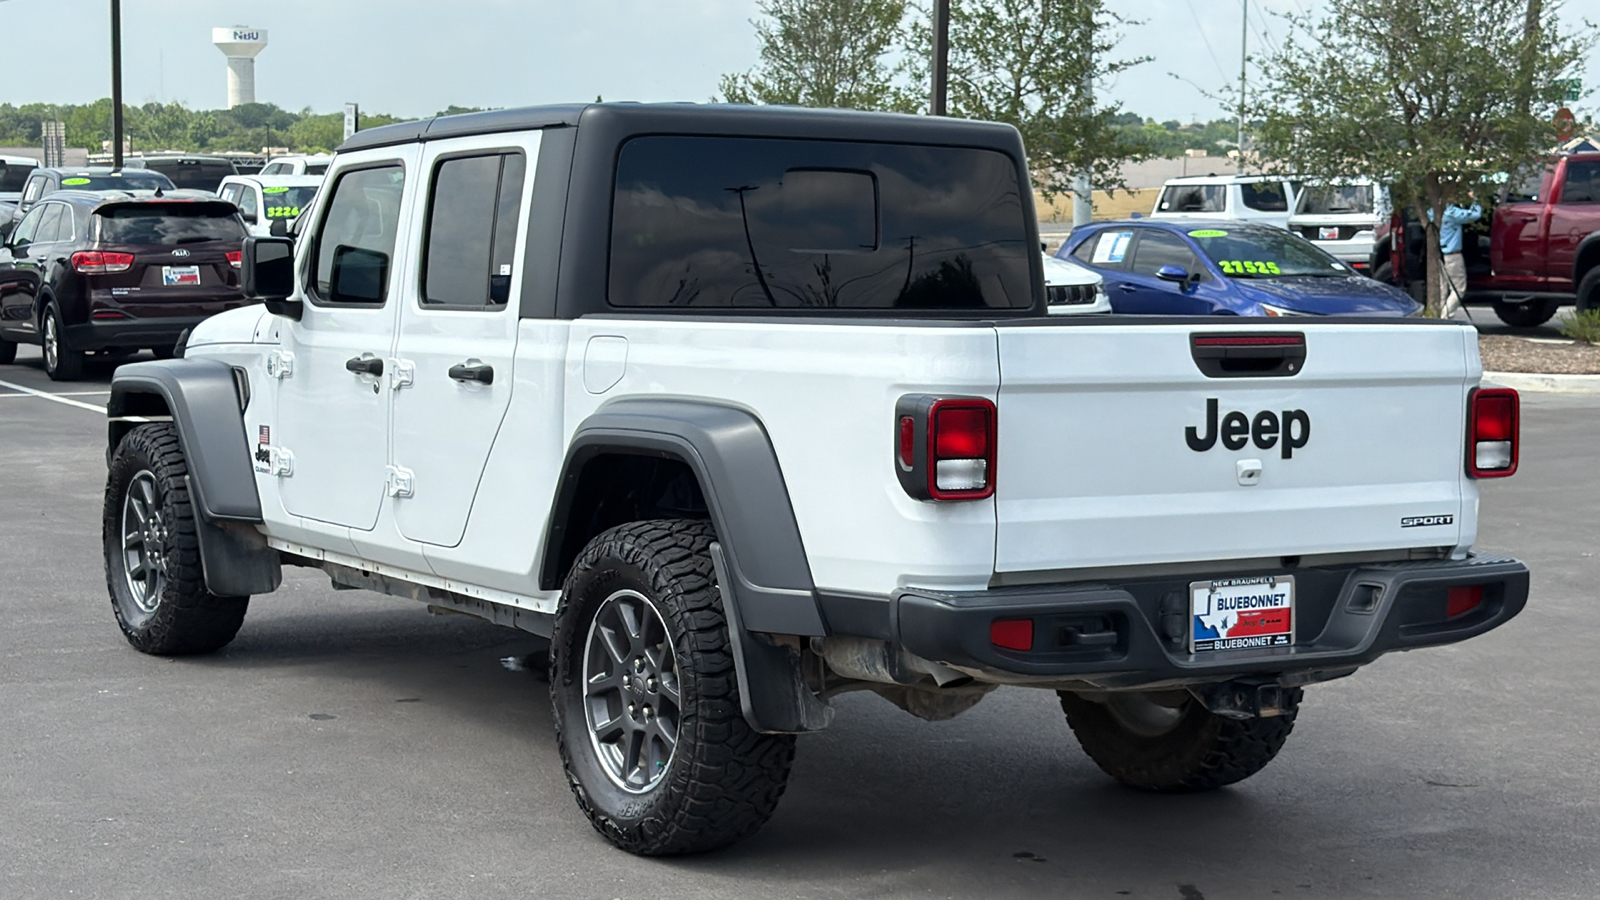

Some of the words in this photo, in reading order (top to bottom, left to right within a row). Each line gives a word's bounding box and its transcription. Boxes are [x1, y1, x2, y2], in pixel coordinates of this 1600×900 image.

[267, 206, 306, 218] 3226
[1218, 260, 1281, 275] 27525
[1185, 398, 1311, 459] Jeep
[1401, 514, 1453, 528] SPORT
[1231, 577, 1274, 586] BRAUNFELS
[1217, 593, 1285, 611] BLUEBONNET
[1214, 636, 1272, 650] BLUEBONNET
